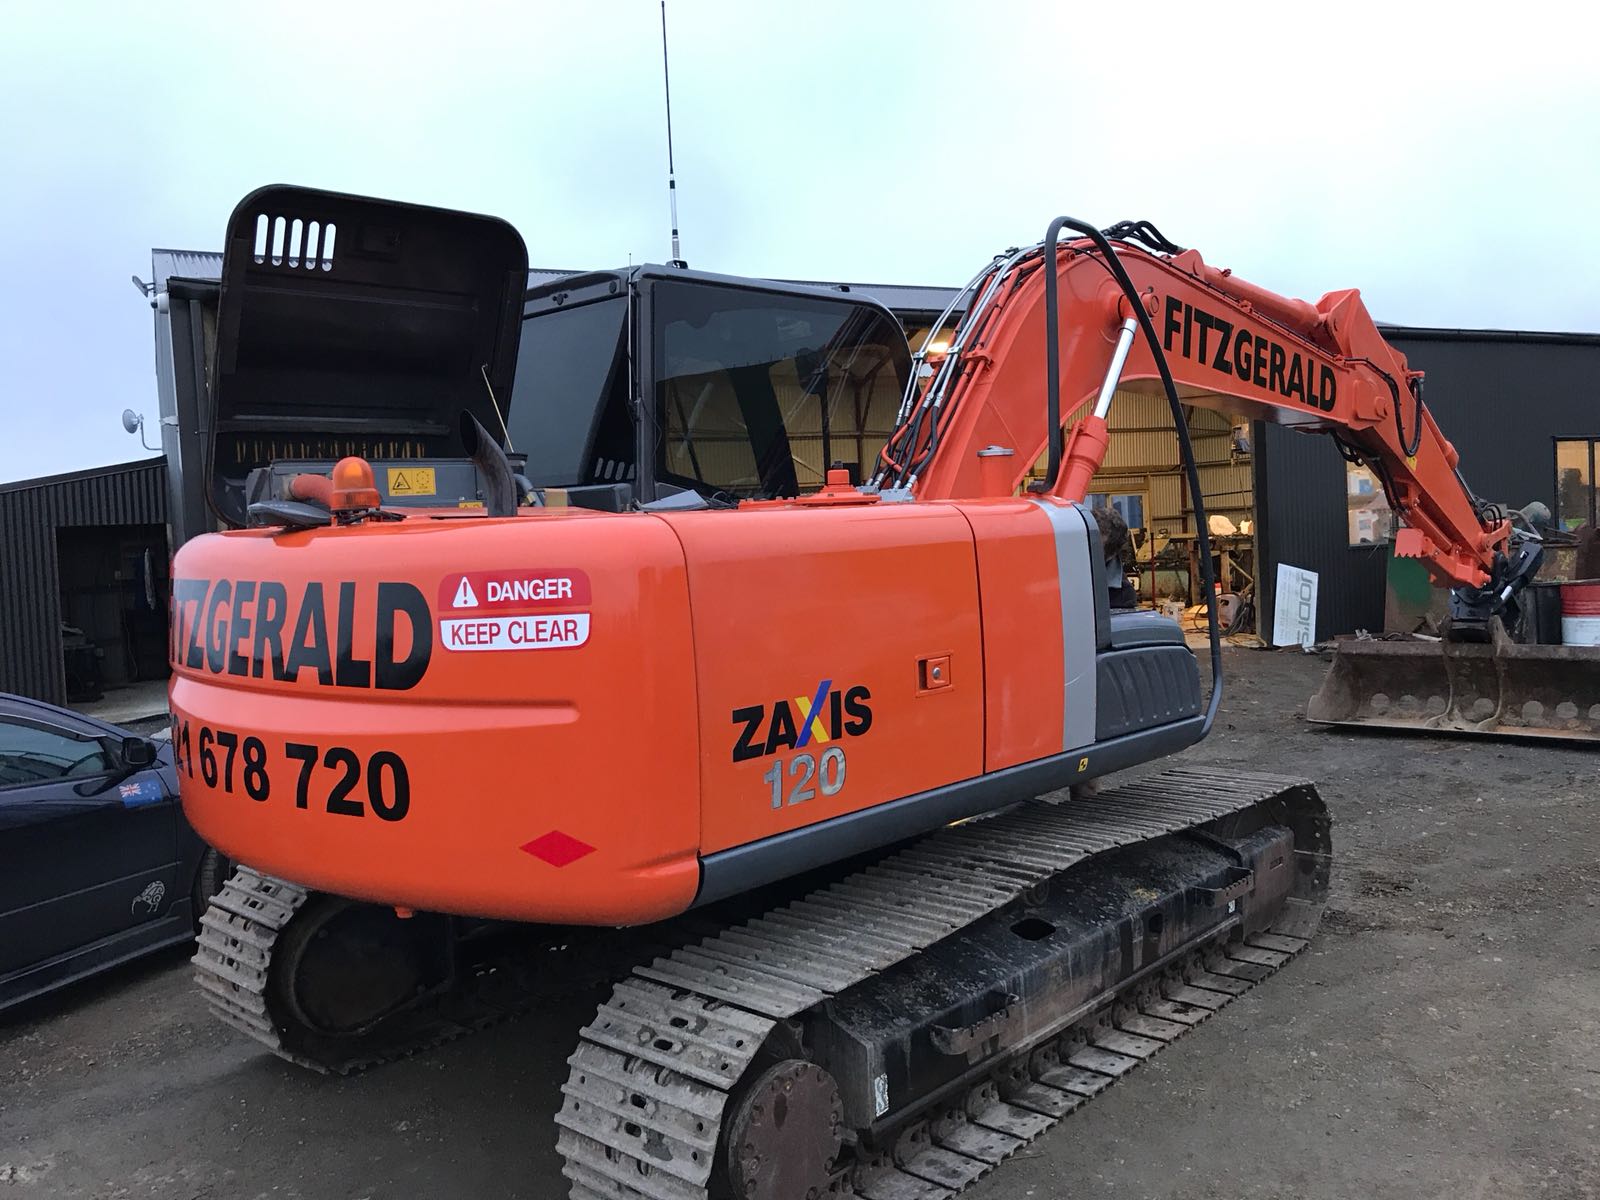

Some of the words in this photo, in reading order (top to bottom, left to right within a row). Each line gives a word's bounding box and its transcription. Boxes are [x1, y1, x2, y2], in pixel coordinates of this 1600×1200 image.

[1163, 294, 1337, 413] FITZGERALD
[487, 577, 573, 602] DANGER
[451, 621, 501, 646] KEEP
[507, 618, 578, 645] CLEAR
[732, 679, 873, 763] ZAXIS
[199, 725, 270, 802] 678
[285, 742, 411, 822] 720
[763, 746, 847, 810] 120
